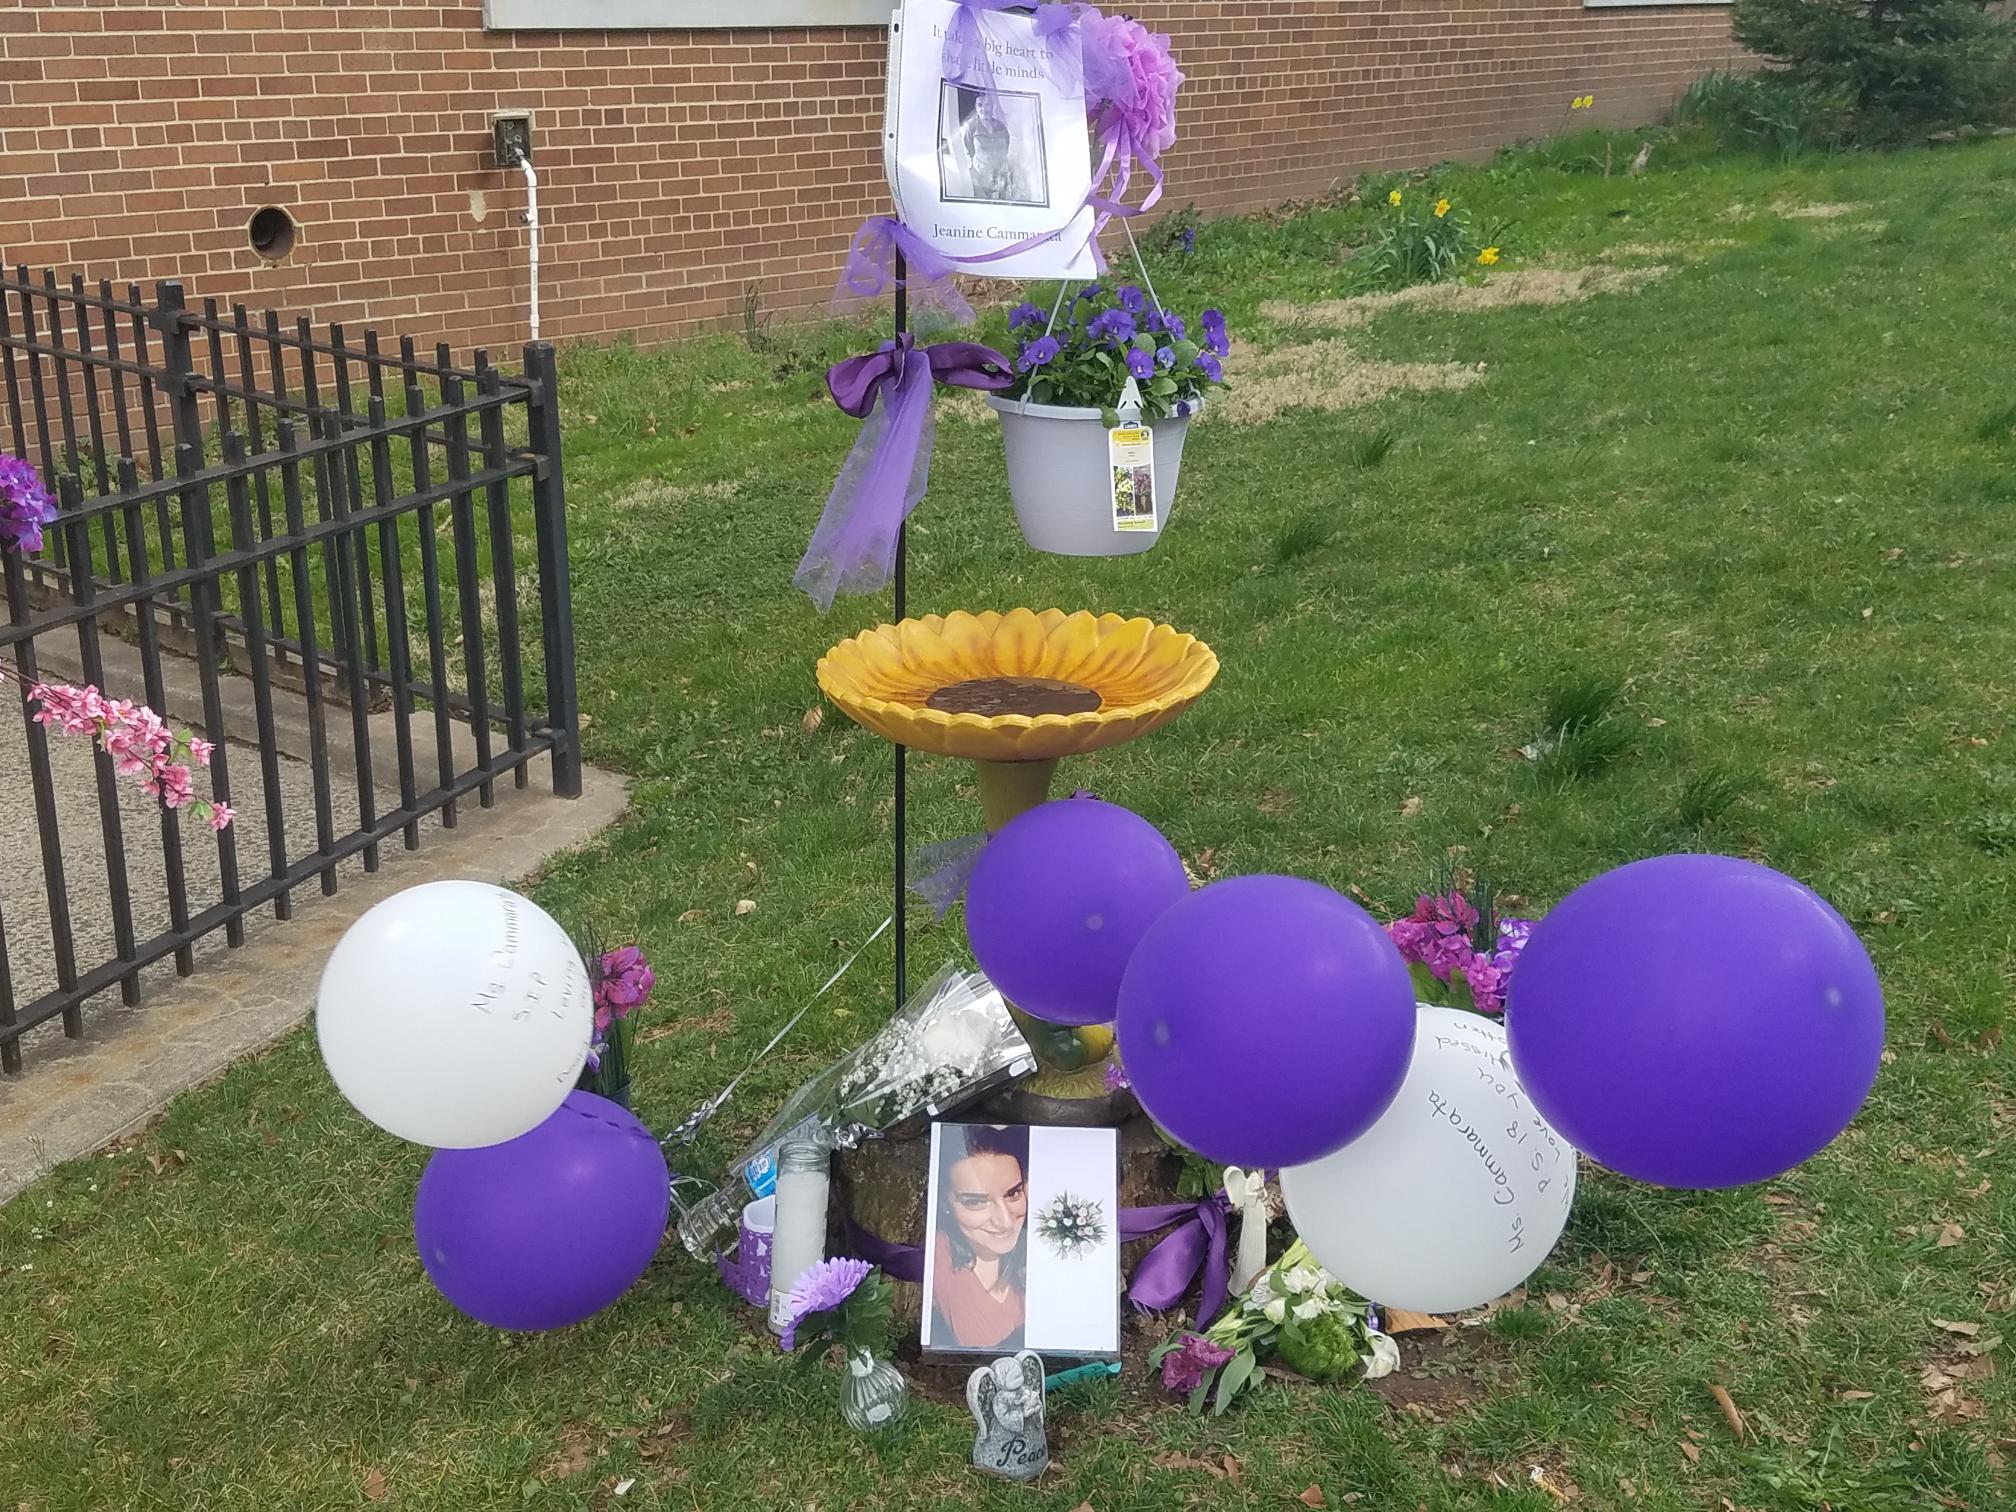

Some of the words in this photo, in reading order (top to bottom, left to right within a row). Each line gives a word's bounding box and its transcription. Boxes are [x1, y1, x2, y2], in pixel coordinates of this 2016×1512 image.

[932, 24, 942, 39] It
[984, 37, 1003, 57] big
[1005, 41, 1035, 58] heart
[1040, 49, 1054, 60] to
[1005, 65, 1045, 80] minds
[932, 223, 983, 239] Jeanine
[1427, 1089, 1515, 1206] Cammarata
